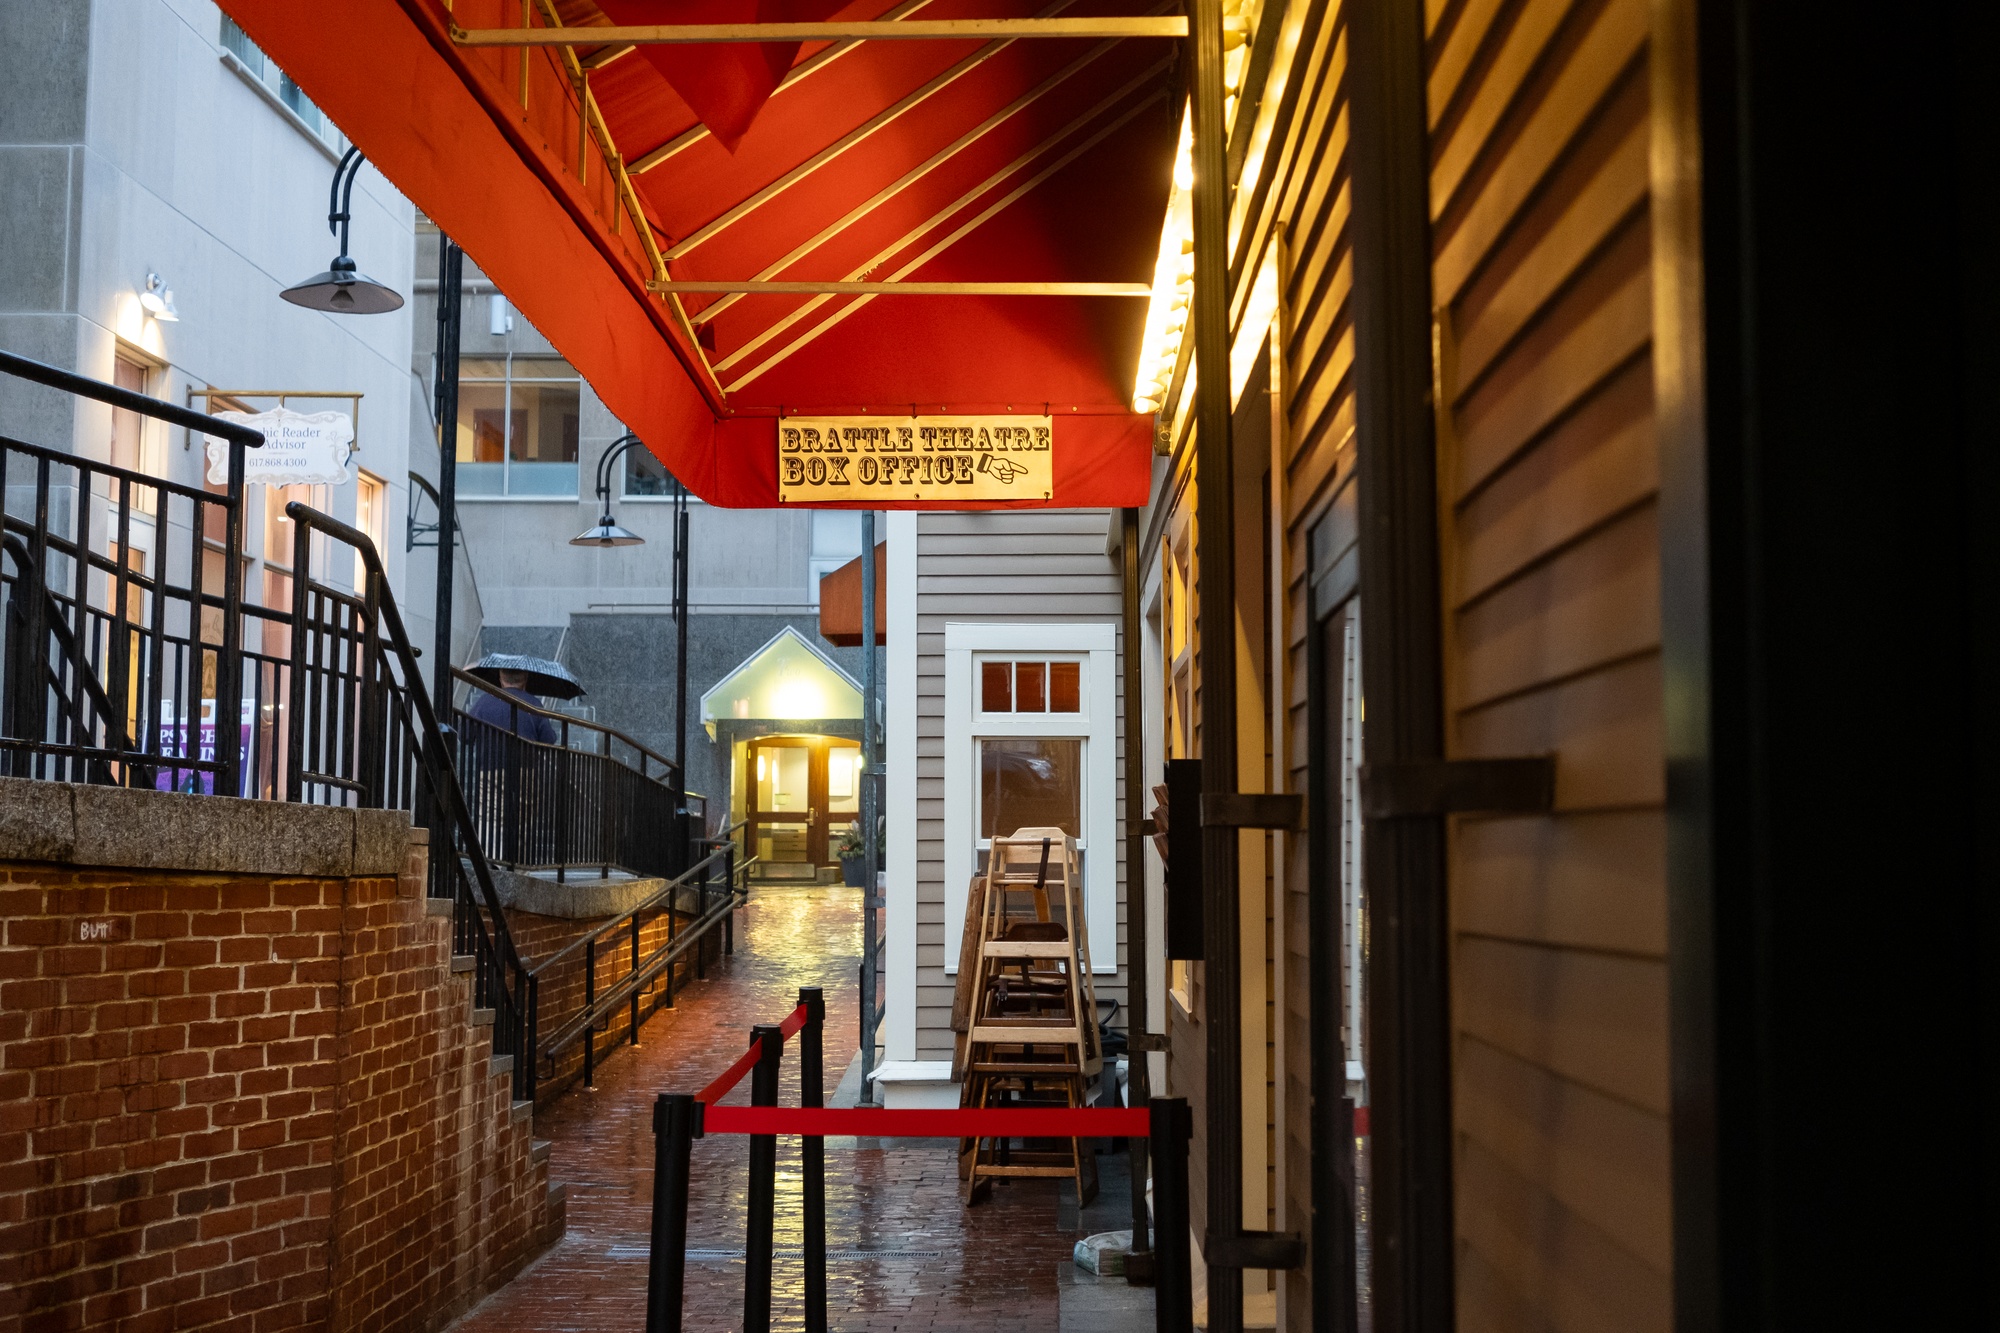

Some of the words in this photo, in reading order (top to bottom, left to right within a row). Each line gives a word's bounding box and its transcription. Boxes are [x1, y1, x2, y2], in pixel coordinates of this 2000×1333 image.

[282, 427, 321, 438] Reader
[262, 439, 307, 450] Advisor
[781, 427, 913, 453] BRATTLE
[919, 426, 1050, 452] THEATRE
[248, 458, 307, 468] 617.868.4300
[781, 455, 850, 486] BOX
[857, 454, 974, 486] OFFICE
